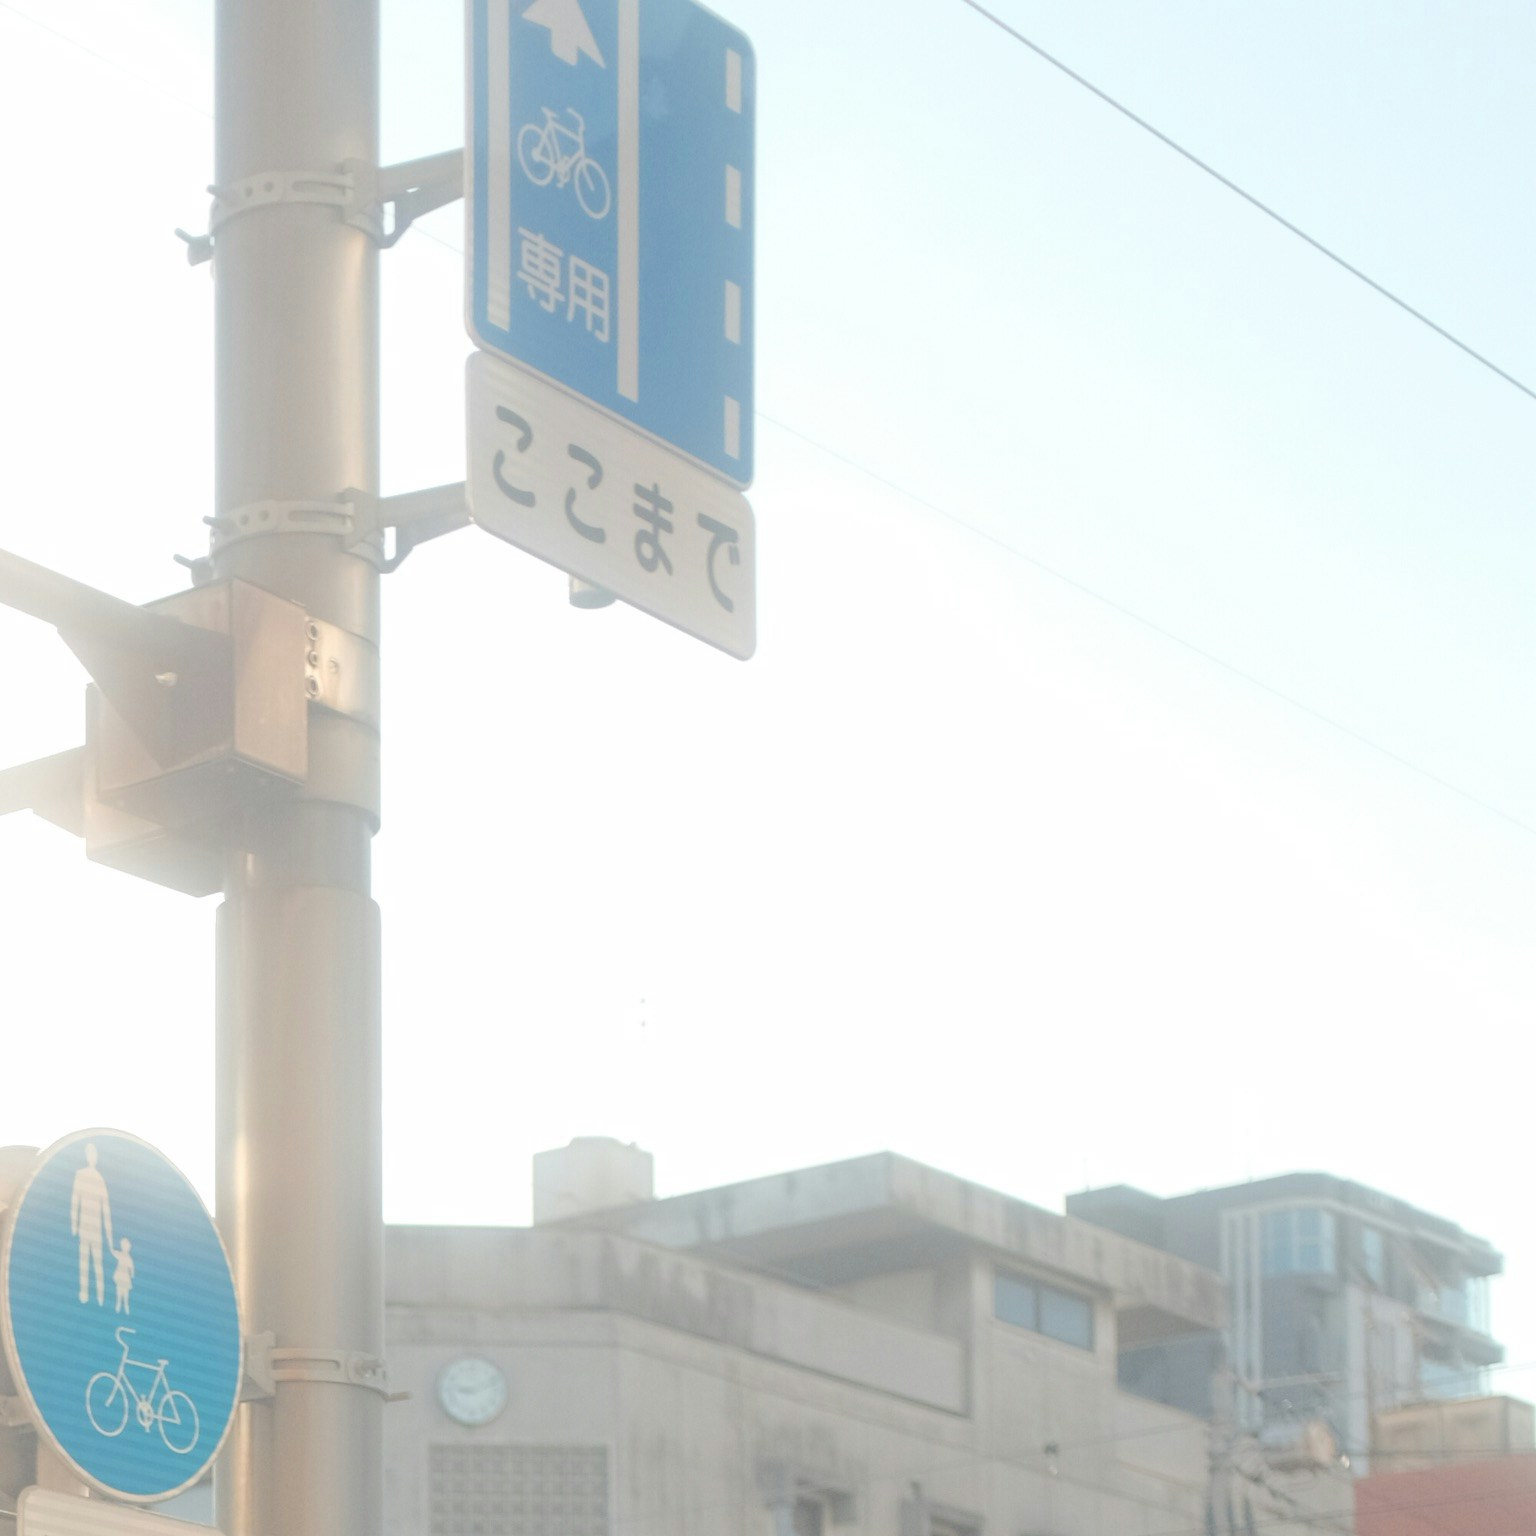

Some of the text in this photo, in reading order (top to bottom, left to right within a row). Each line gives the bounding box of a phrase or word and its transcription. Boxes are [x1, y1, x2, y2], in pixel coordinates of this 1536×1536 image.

[517, 229, 610, 342] 専用
[493, 406, 741, 611] ここまで
